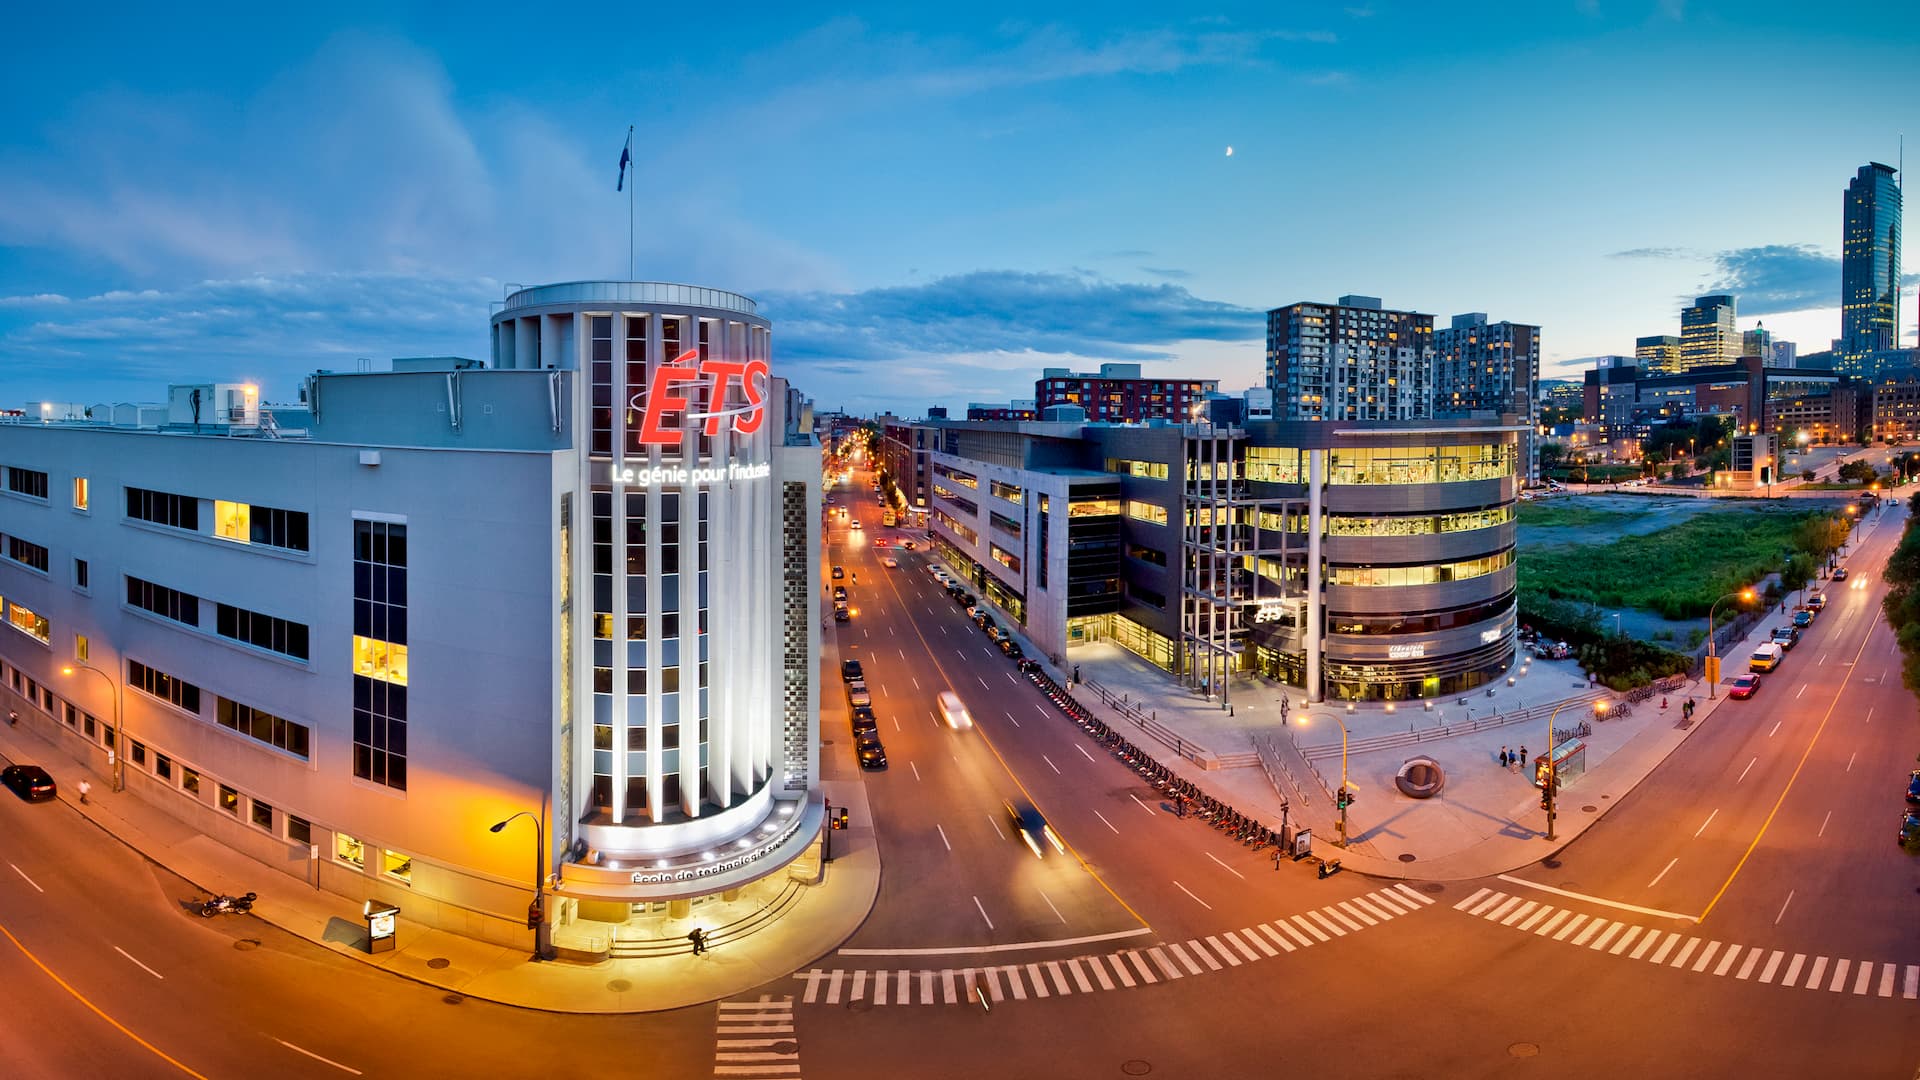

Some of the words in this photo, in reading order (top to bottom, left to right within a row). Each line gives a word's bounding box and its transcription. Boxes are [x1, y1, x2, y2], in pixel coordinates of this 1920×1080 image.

[638, 349, 769, 444] ÉTS
[612, 464, 634, 482] Le
[638, 465, 688, 486] génie
[692, 468, 727, 486] pour
[632, 871, 672, 884] École
[677, 870, 694, 881] de
